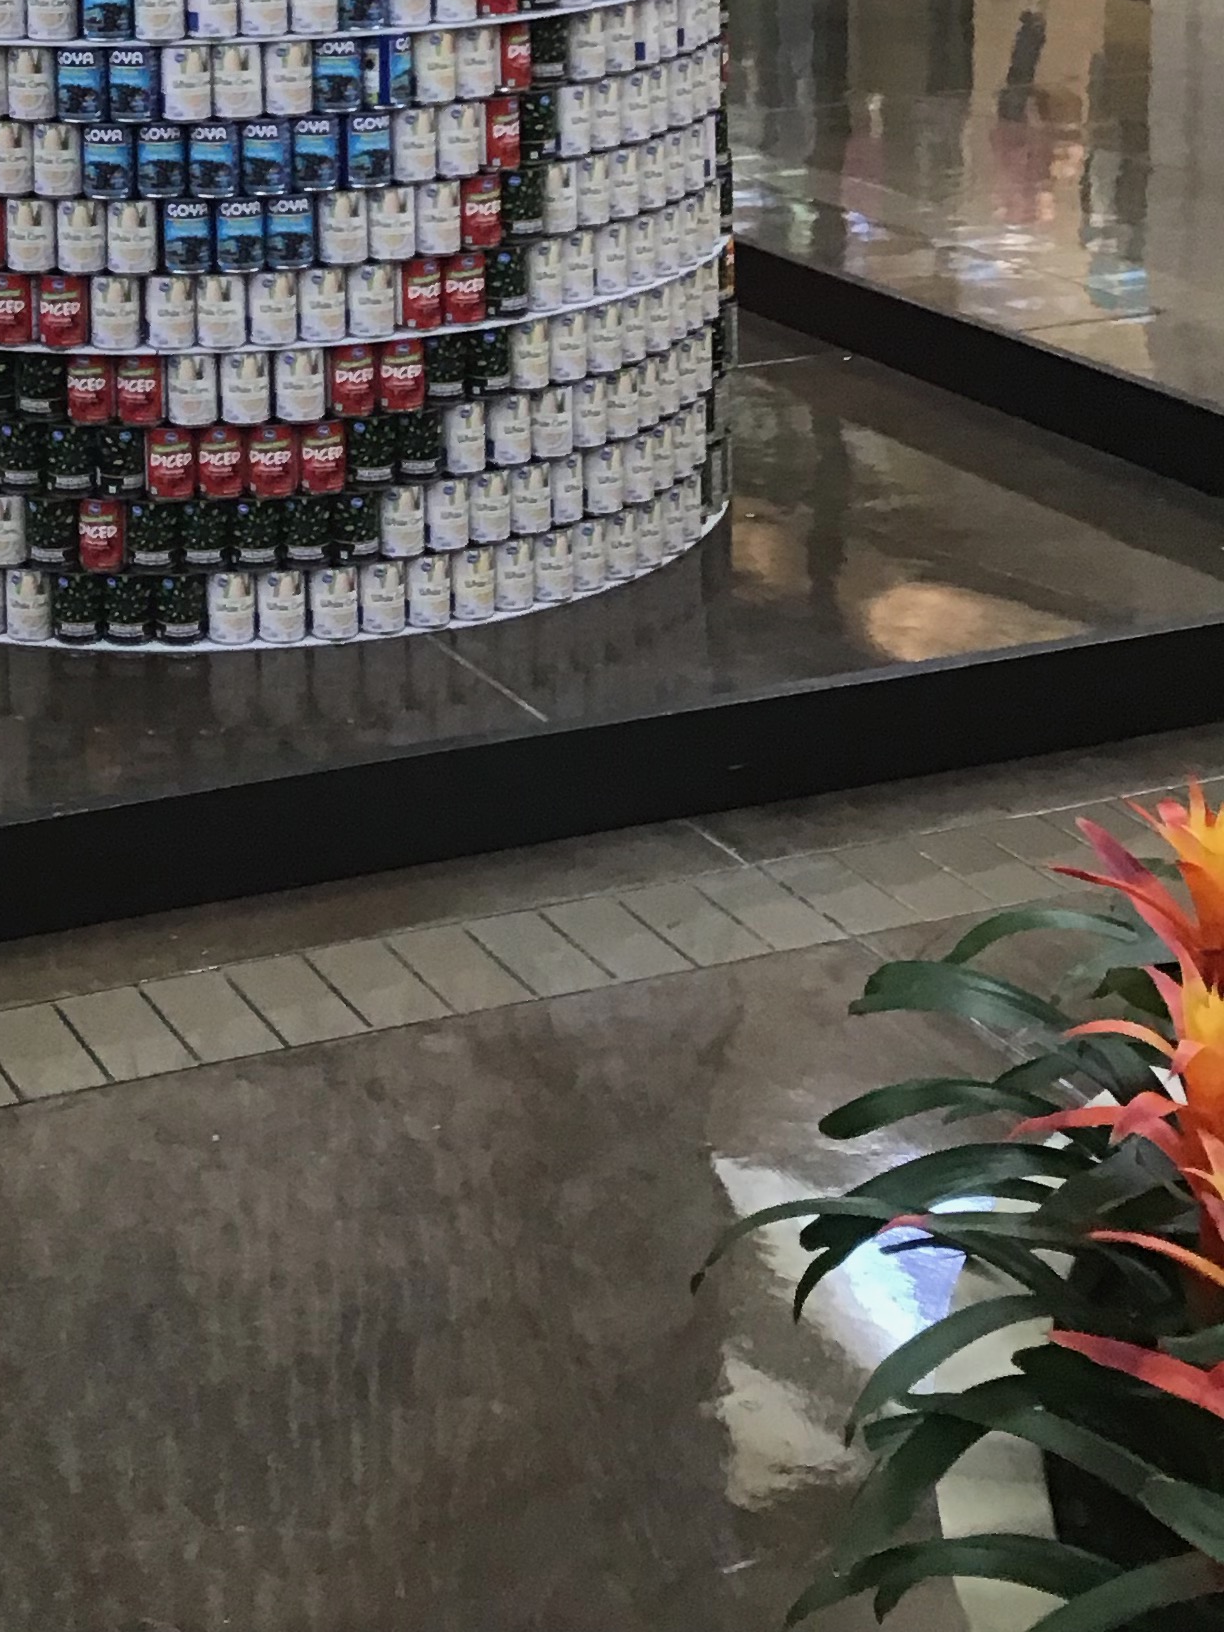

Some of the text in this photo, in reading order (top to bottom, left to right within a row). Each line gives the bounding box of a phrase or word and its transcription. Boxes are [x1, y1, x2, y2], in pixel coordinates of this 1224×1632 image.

[465, 199, 501, 215] DICED
[445, 278, 485, 293] DICED
[39, 301, 80, 316] DICED
[335, 368, 374, 384] DICED
[381, 364, 423, 379] DICED
[68, 377, 106, 391] DICED
[117, 378, 156, 392] DICED
[151, 453, 192, 468] DICED
[199, 451, 241, 465] DICED
[249, 450, 292, 465] DICED
[302, 446, 343, 460] DICED
[79, 523, 117, 538] DICED
